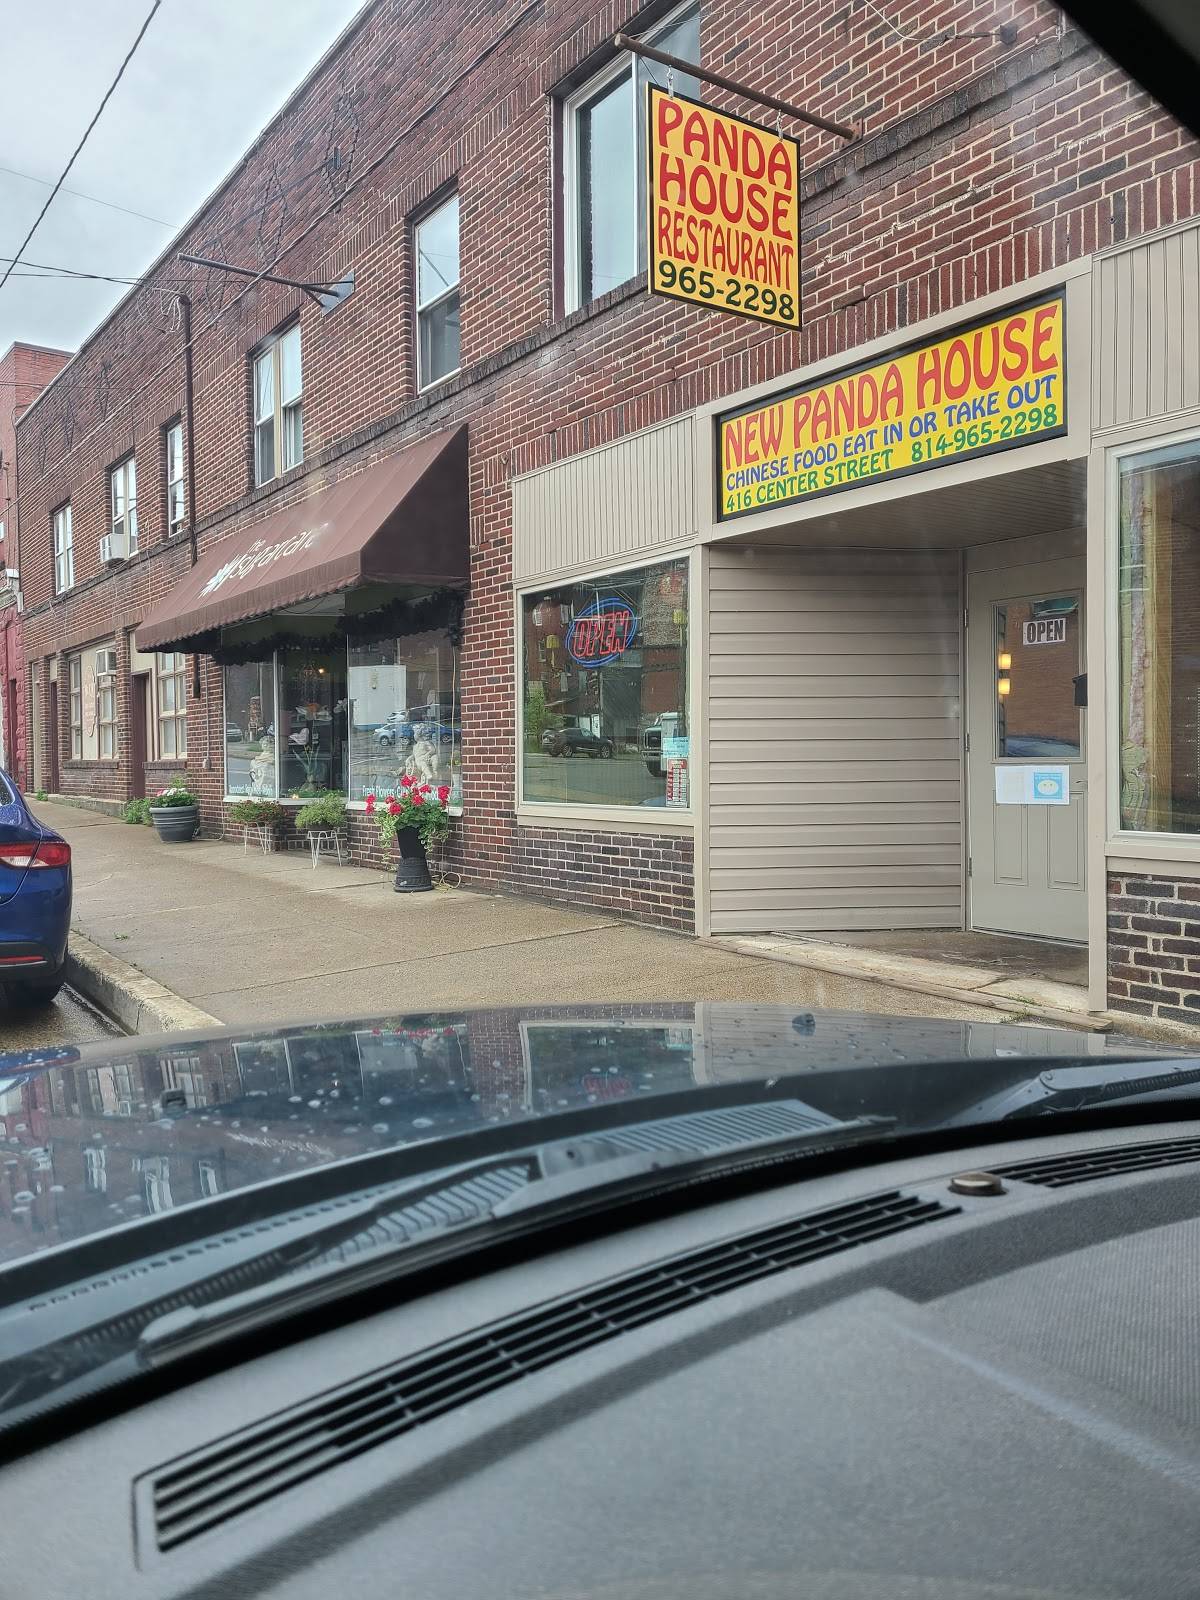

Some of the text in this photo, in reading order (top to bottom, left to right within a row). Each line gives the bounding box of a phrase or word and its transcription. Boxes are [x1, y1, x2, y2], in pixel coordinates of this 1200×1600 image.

[658, 98, 792, 190] PANDA
[659, 152, 793, 241] HOUSE
[658, 205, 794, 290] RESTAURANT
[658, 260, 795, 320] 965-2298
[725, 304, 1058, 470] NEW PANDA HOUSE
[726, 374, 1057, 491] CHINESE FOOD EAT IN OR TAKE OUT
[726, 403, 1058, 512] 416 CENTER STREET 814-965-2298
[573, 610, 630, 659] OPEN
[1026, 619, 1064, 644] OPEN
